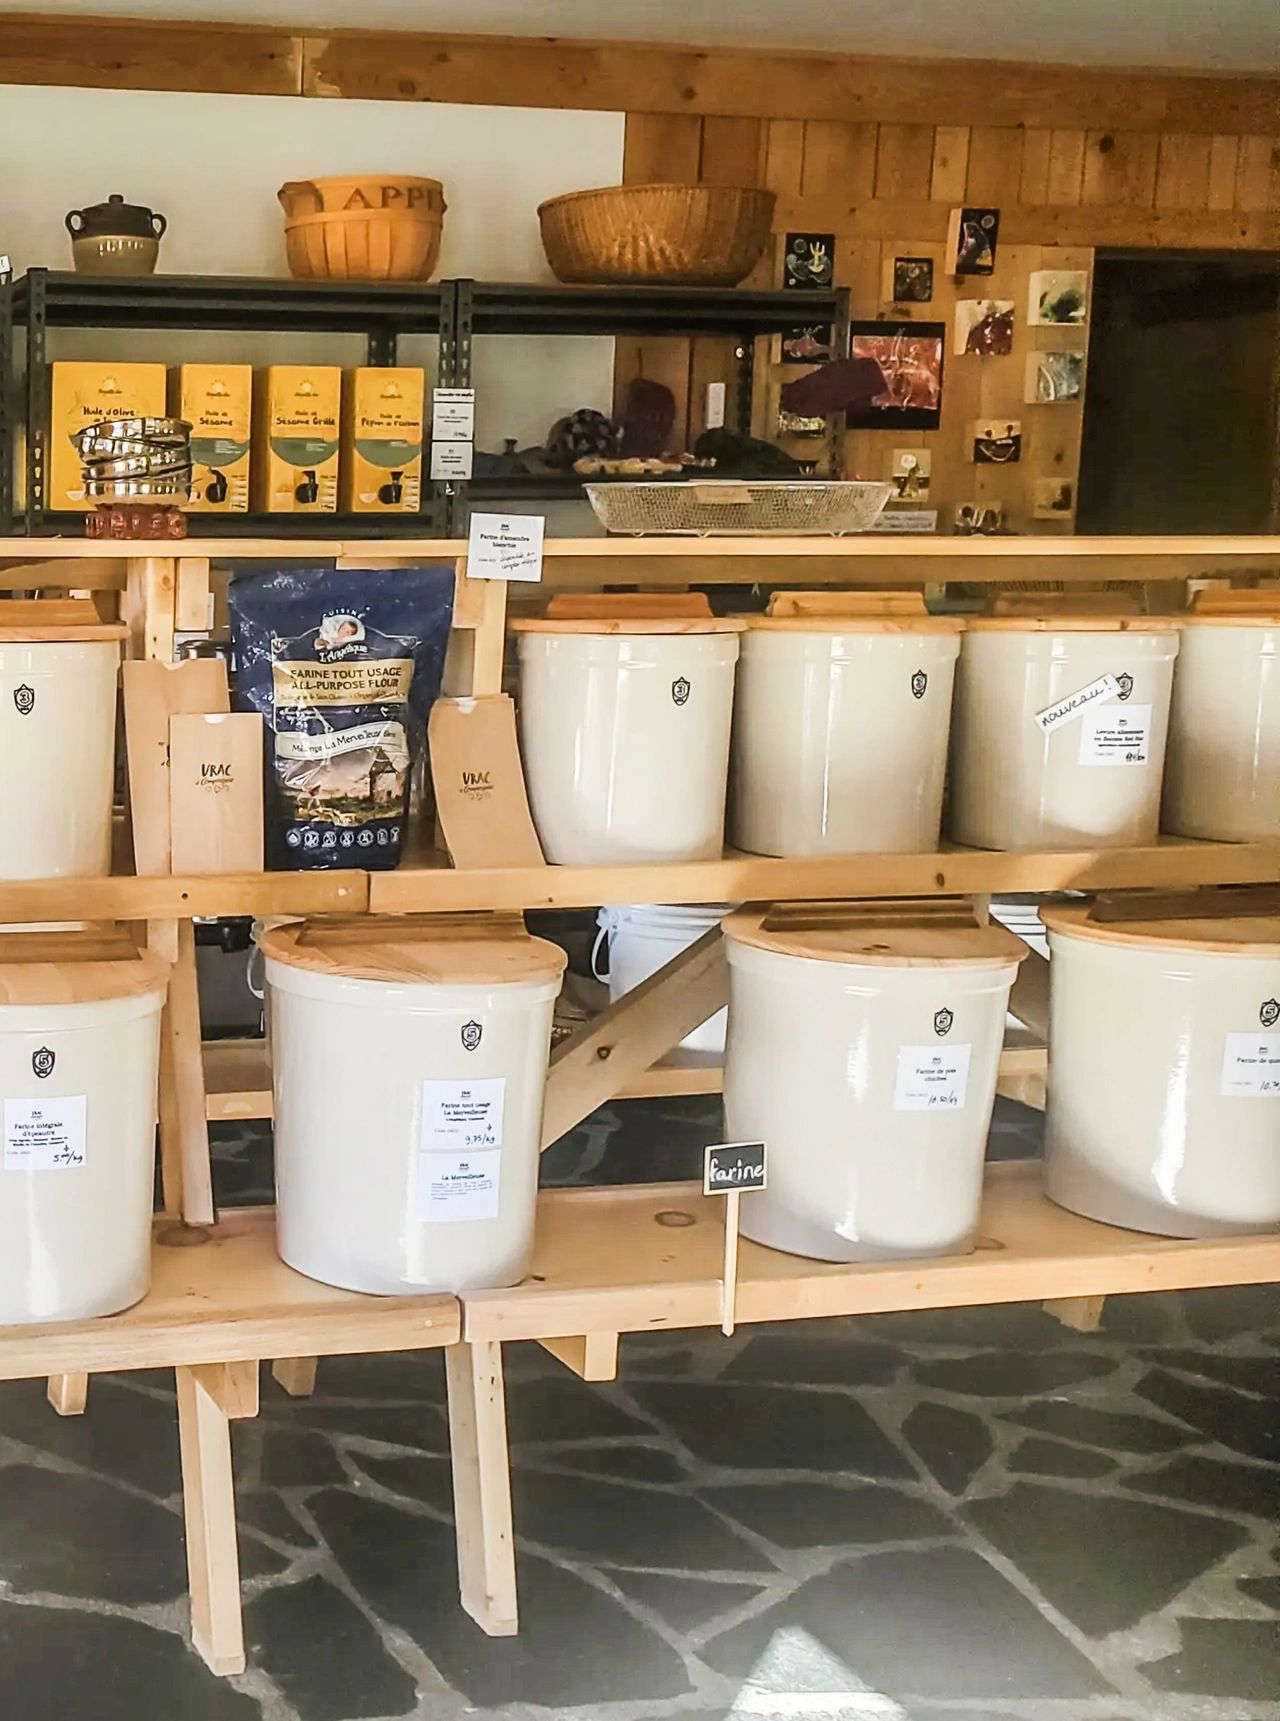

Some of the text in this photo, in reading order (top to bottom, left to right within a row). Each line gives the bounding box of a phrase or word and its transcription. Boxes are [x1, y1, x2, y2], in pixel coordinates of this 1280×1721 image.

[290, 667, 402, 680] FARINE TOUT USAGE
[292, 678, 400, 690] ALL-PURPOSE FLOUR
[201, 763, 232, 778] VRAC
[462, 771, 490, 785] VRAC
